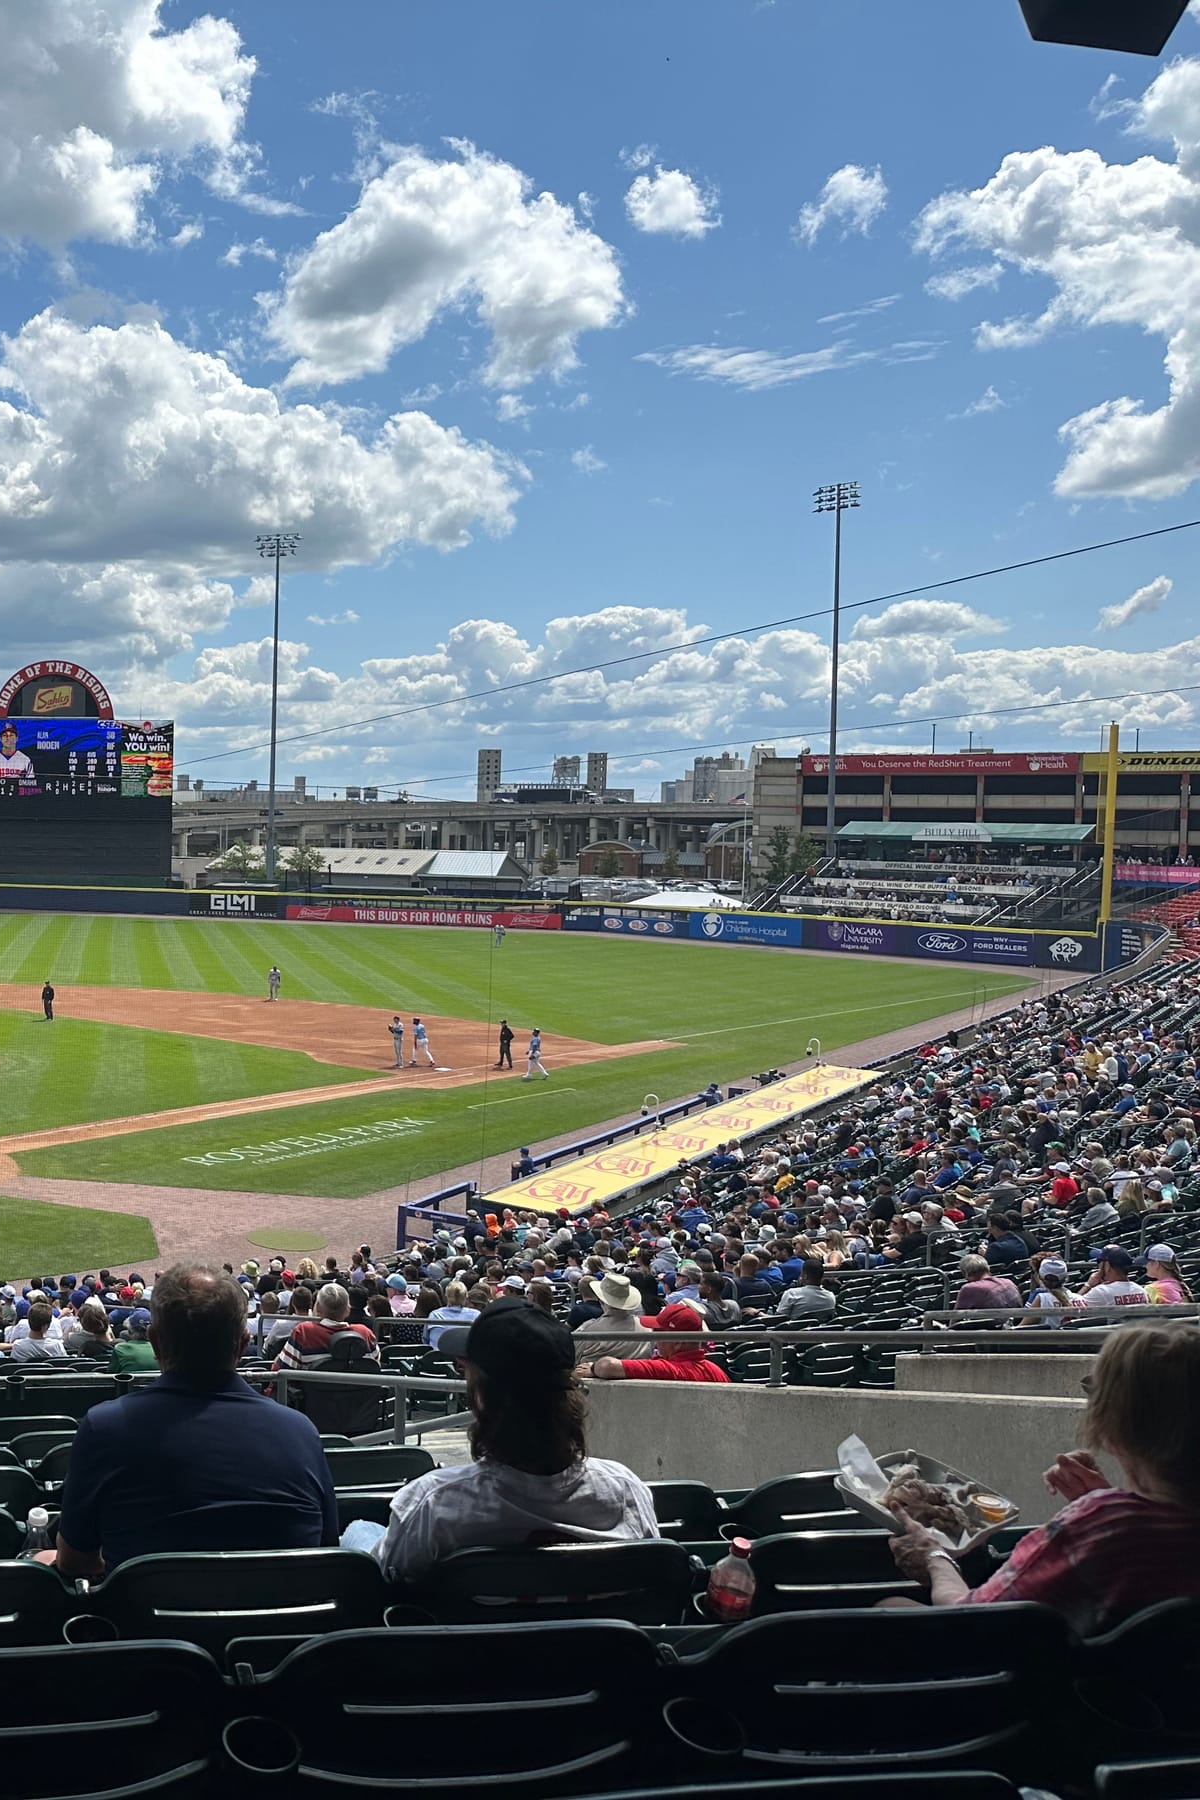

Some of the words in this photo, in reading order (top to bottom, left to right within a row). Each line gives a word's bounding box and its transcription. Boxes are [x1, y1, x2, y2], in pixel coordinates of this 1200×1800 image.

[25, 665, 41, 678] OF
[46, 662, 73, 675] THE
[75, 668, 110, 709] BISONS
[128, 732, 144, 742] We
[146, 733, 167, 742] win.
[125, 743, 147, 751] YOU
[149, 743, 170, 751] win!
[861, 760, 876, 769] You
[878, 760, 910, 768] Deserve
[913, 760, 926, 768] the
[928, 760, 965, 768] RedShirt
[1026, 755, 1064, 763] Independent
[46, 783, 52, 791] R
[924, 828, 955, 836] BULLY
[210, 894, 256, 911] GLMI
[354, 910, 376, 921] THIS
[378, 911, 408, 922] BUD'S
[410, 912, 430, 923] FOR
[432, 913, 462, 924] HOME
[464, 914, 492, 925] RUNS
[725, 924, 758, 934] Children's
[759, 928, 787, 937] Hospital
[843, 923, 883, 937] NIAGARA
[844, 932, 883, 945] UNIVERSITY
[925, 934, 958, 951] Ford
[973, 942, 993, 950] FORD
[994, 943, 1028, 952] DEALERS
[1055, 942, 1077, 954] 325
[181, 1131, 341, 1166] ROSWELL
[341, 1116, 435, 1139] PARK
